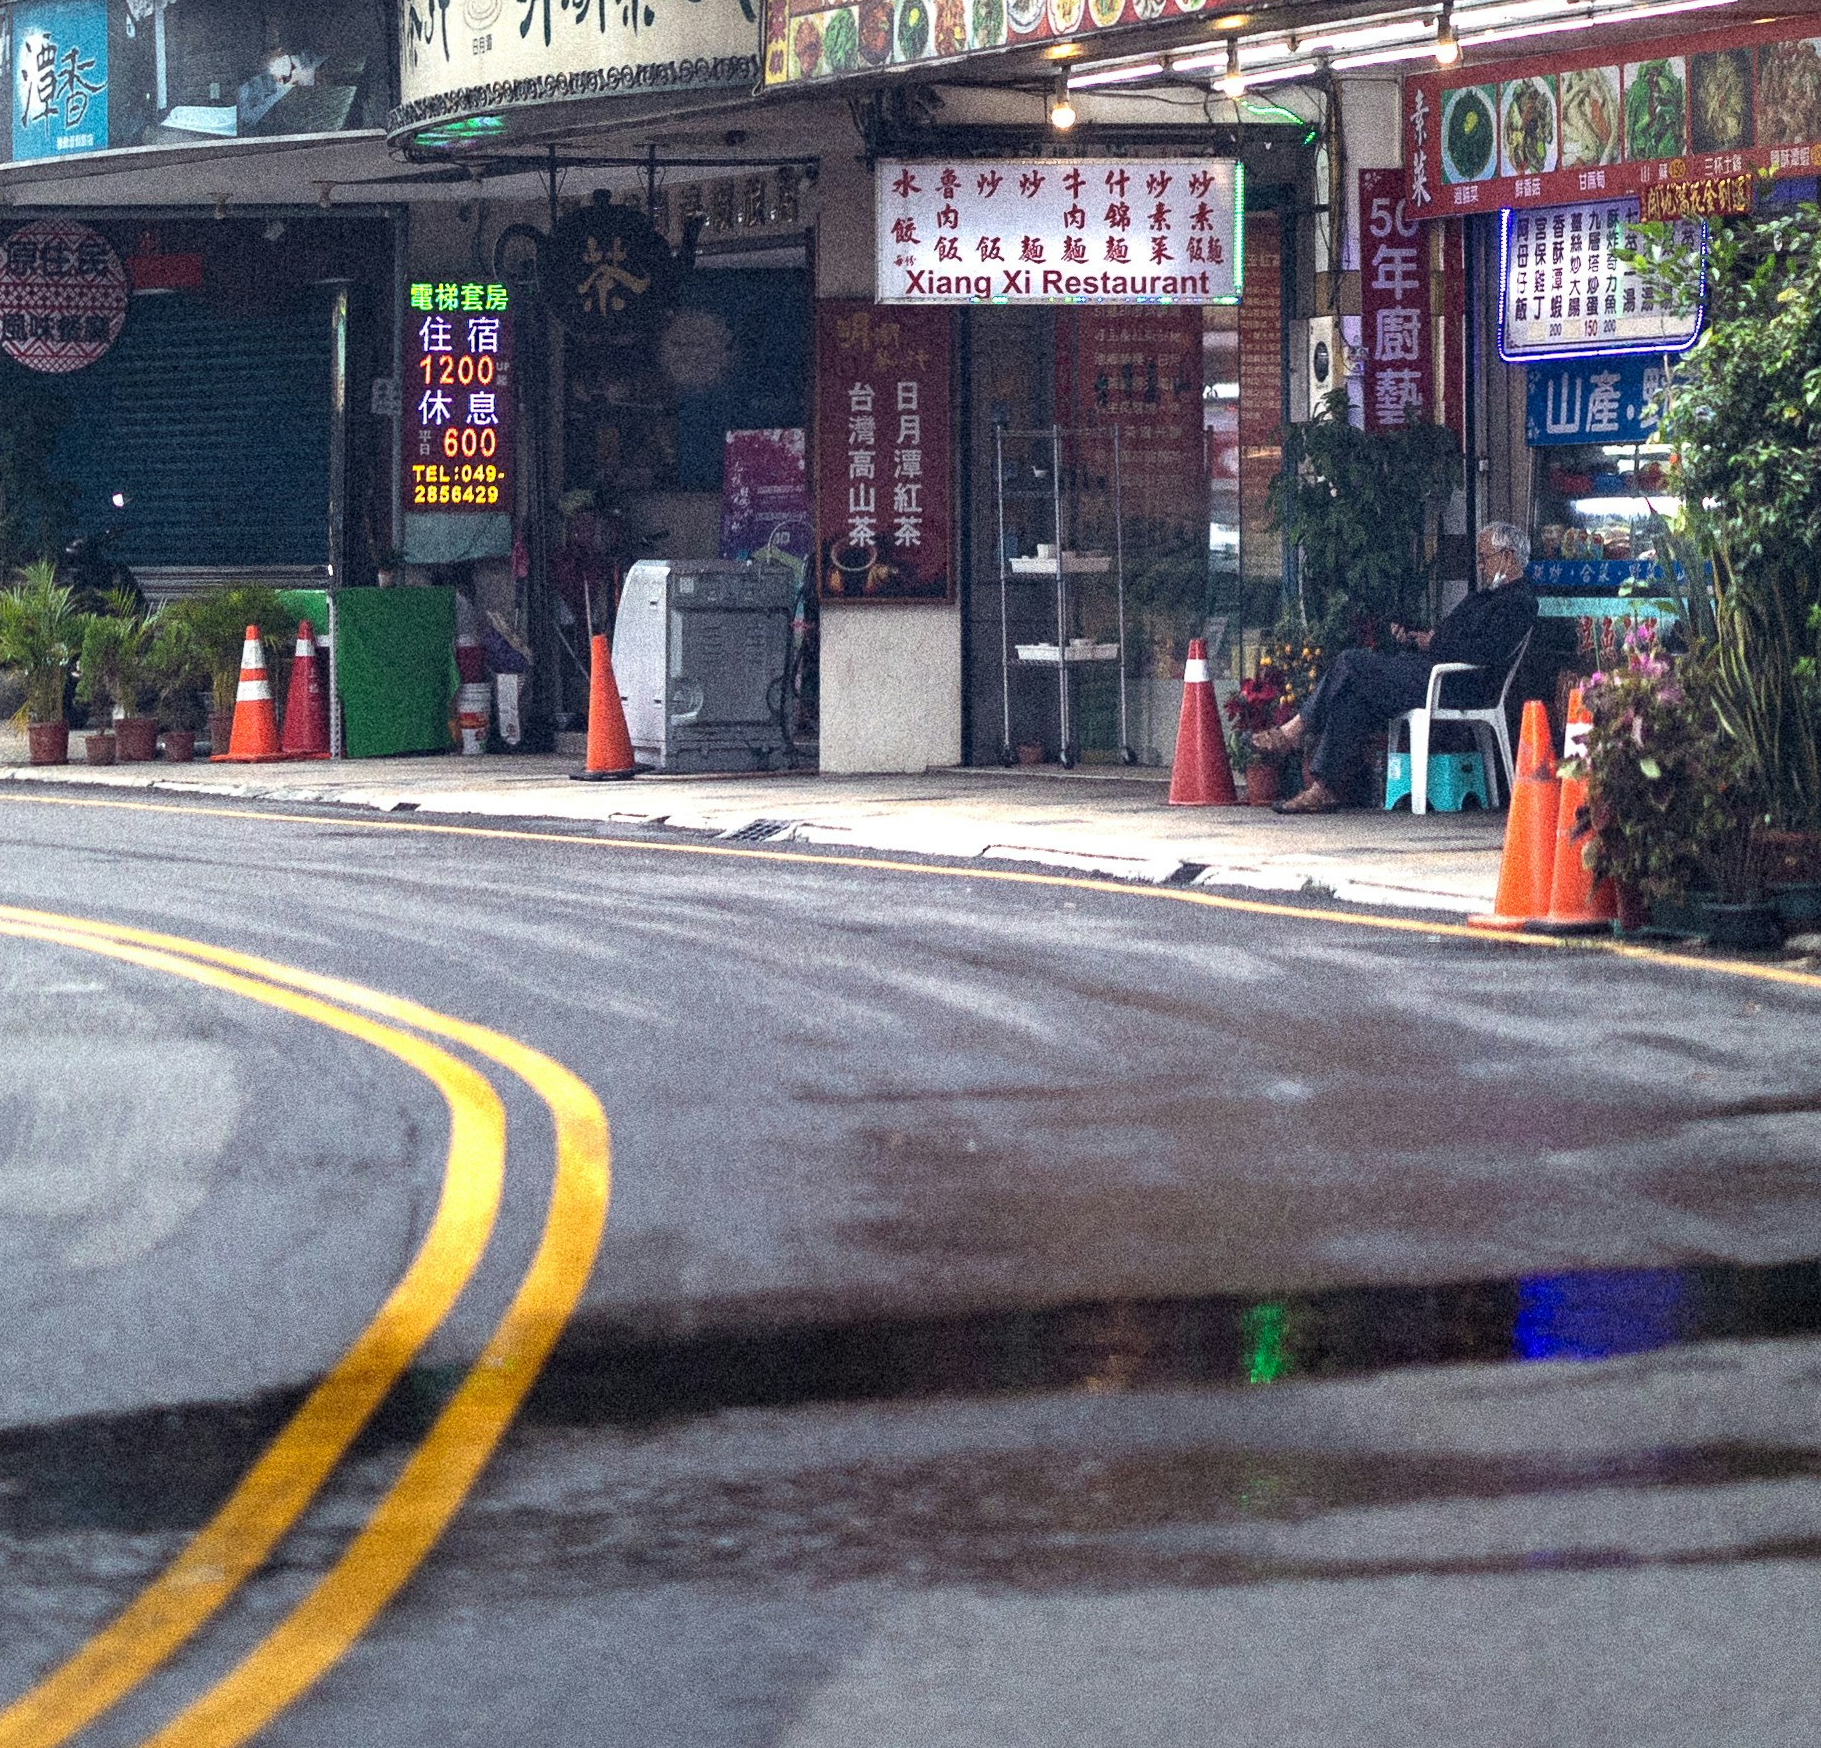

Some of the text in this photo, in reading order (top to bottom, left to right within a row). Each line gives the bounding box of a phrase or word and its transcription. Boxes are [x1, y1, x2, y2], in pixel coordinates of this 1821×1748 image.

[21, 33, 107, 134] 潭香
[1410, 89, 1431, 208] 素菜
[891, 169, 922, 244] 水餃
[934, 168, 962, 264] 魯肉飯
[976, 168, 1005, 264] 炒飯
[1018, 168, 1047, 264] 炒麵
[1061, 168, 1089, 264] 牛肉麵
[1104, 168, 1140, 264] 什錦麵
[1146, 168, 1174, 264] 炒素菜
[410, 283, 509, 311] 電梯套房
[578, 237, 651, 315] 茶
[905, 270, 1210, 298] Xiang Xi Restaurant
[419, 317, 500, 353] 住宿
[1549, 324, 1562, 337] 200
[1584, 320, 1598, 337] 150
[1603, 320, 1616, 333] 200
[419, 355, 494, 385] 1200
[418, 391, 499, 426] 休息
[443, 428, 497, 459] 600
[412, 465, 506, 484] TEL:049-
[414, 485, 499, 504] 2856429
[848, 381, 876, 548] 台灣高山茶
[894, 381, 922, 548] 日月潭紅茶
